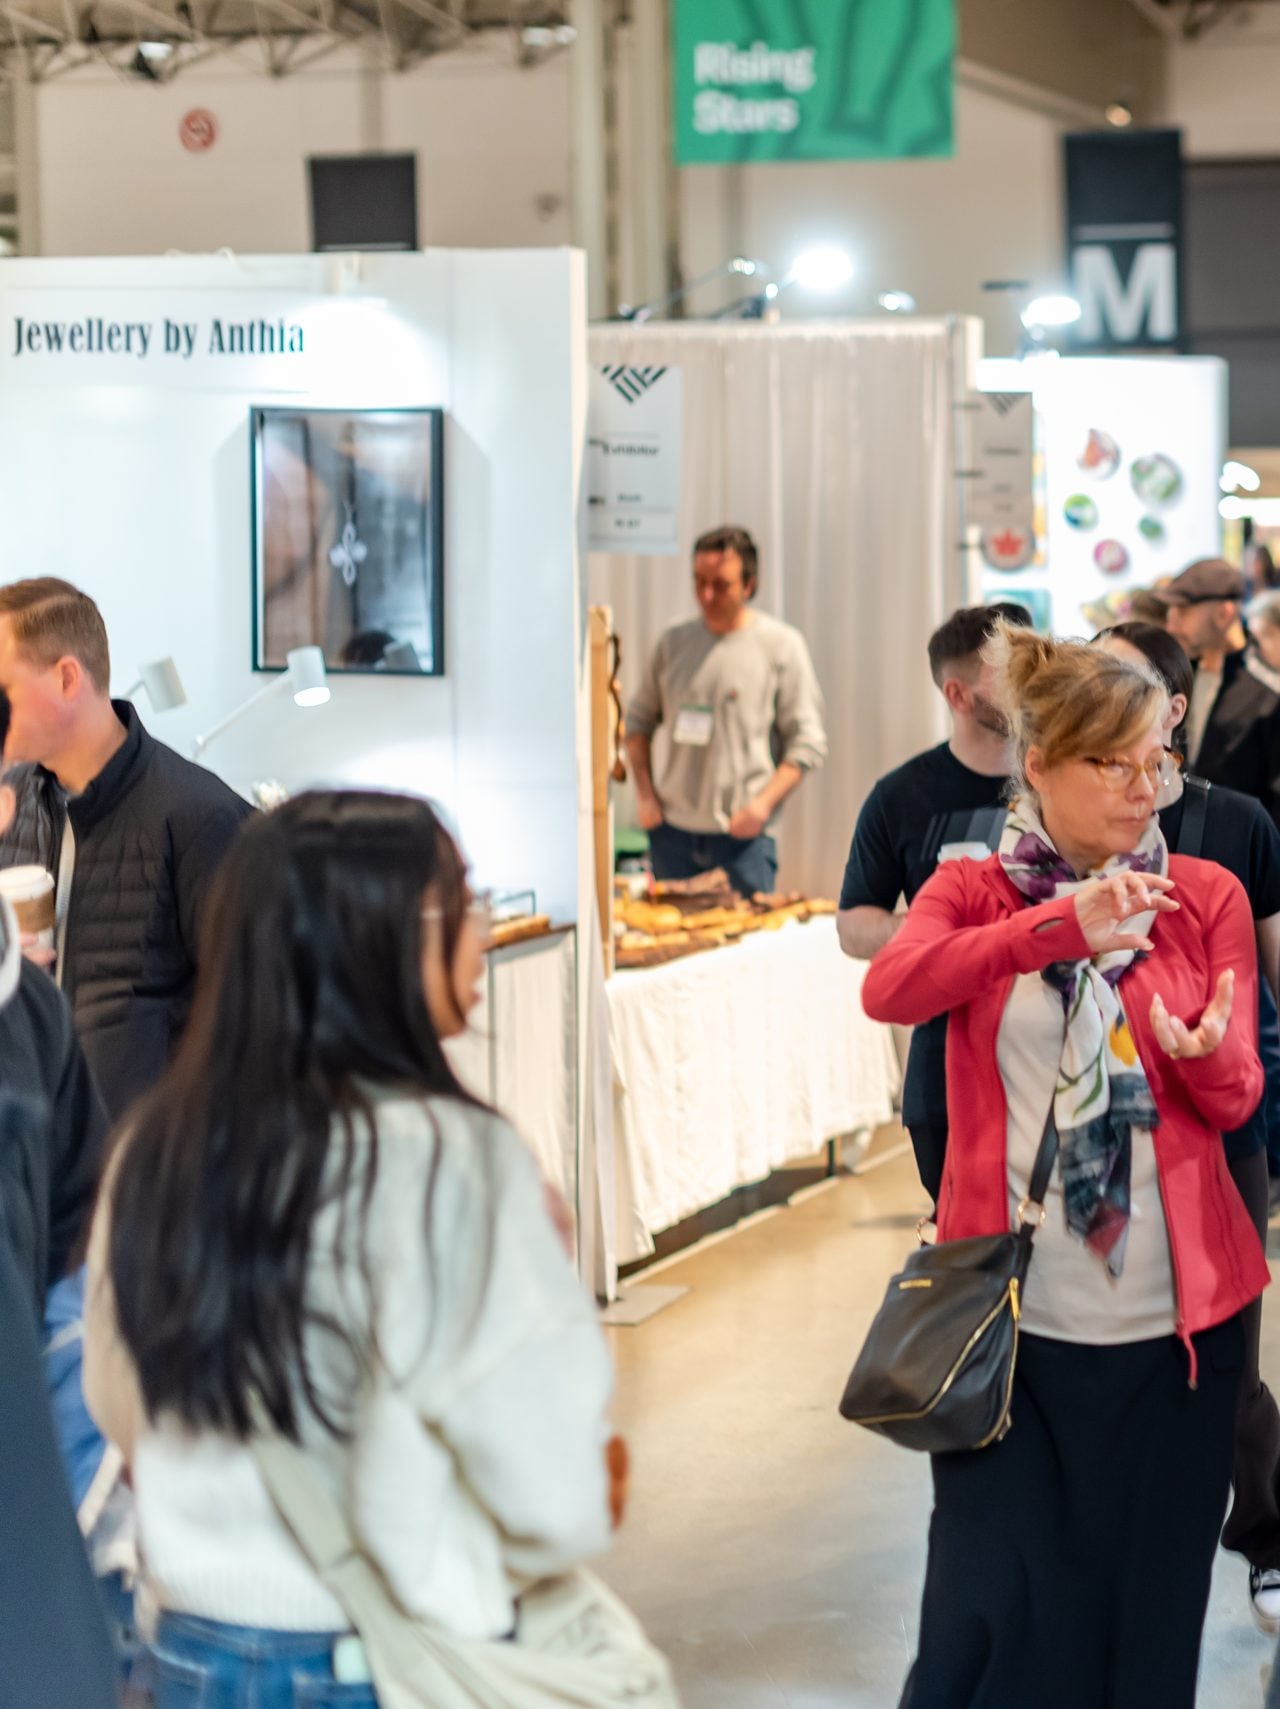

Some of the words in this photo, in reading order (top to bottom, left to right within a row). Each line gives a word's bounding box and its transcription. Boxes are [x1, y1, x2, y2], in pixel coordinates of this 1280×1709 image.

[692, 40, 816, 93] Rising
[692, 90, 799, 133] Stars
[1073, 243, 1178, 341] M
[12, 317, 151, 358] Jewellery
[163, 318, 197, 359] by
[209, 318, 304, 353] Anthia
